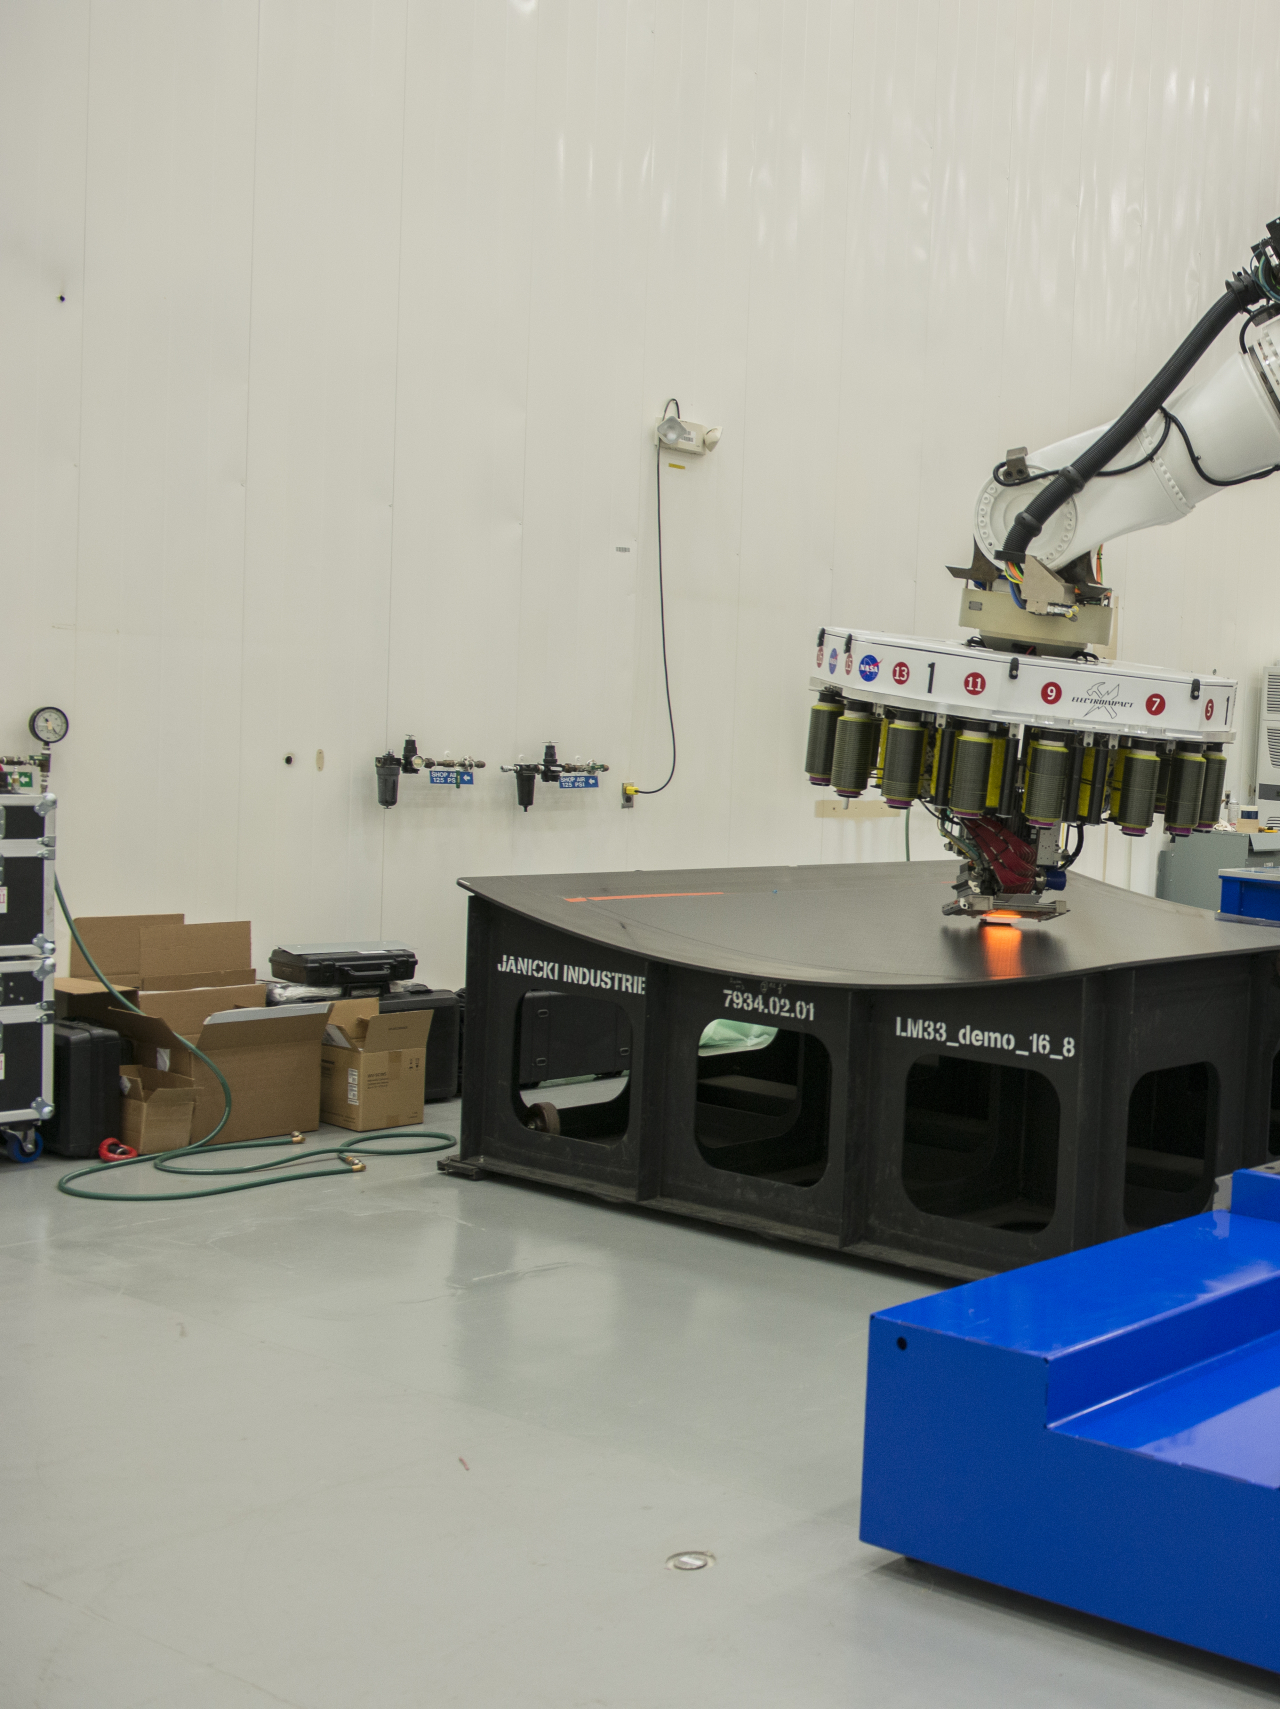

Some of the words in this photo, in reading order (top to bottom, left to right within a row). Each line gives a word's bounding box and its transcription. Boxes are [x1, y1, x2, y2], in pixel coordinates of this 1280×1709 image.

[860, 663, 879, 673] NASA
[894, 666, 908, 681] 13
[927, 662, 936, 694] 1
[966, 676, 983, 692] 11
[1046, 686, 1057, 701] 9
[1071, 696, 1134, 708] ELECTROIMPACT
[1151, 697, 1161, 711] 7
[1206, 703, 1213, 717] 5
[497, 954, 559, 981] JANICKI
[562, 964, 646, 995] INDUSTRIE
[722, 989, 815, 1021] 7934.02.01
[895, 1016, 1076, 1060] LM33_demo_16_8
